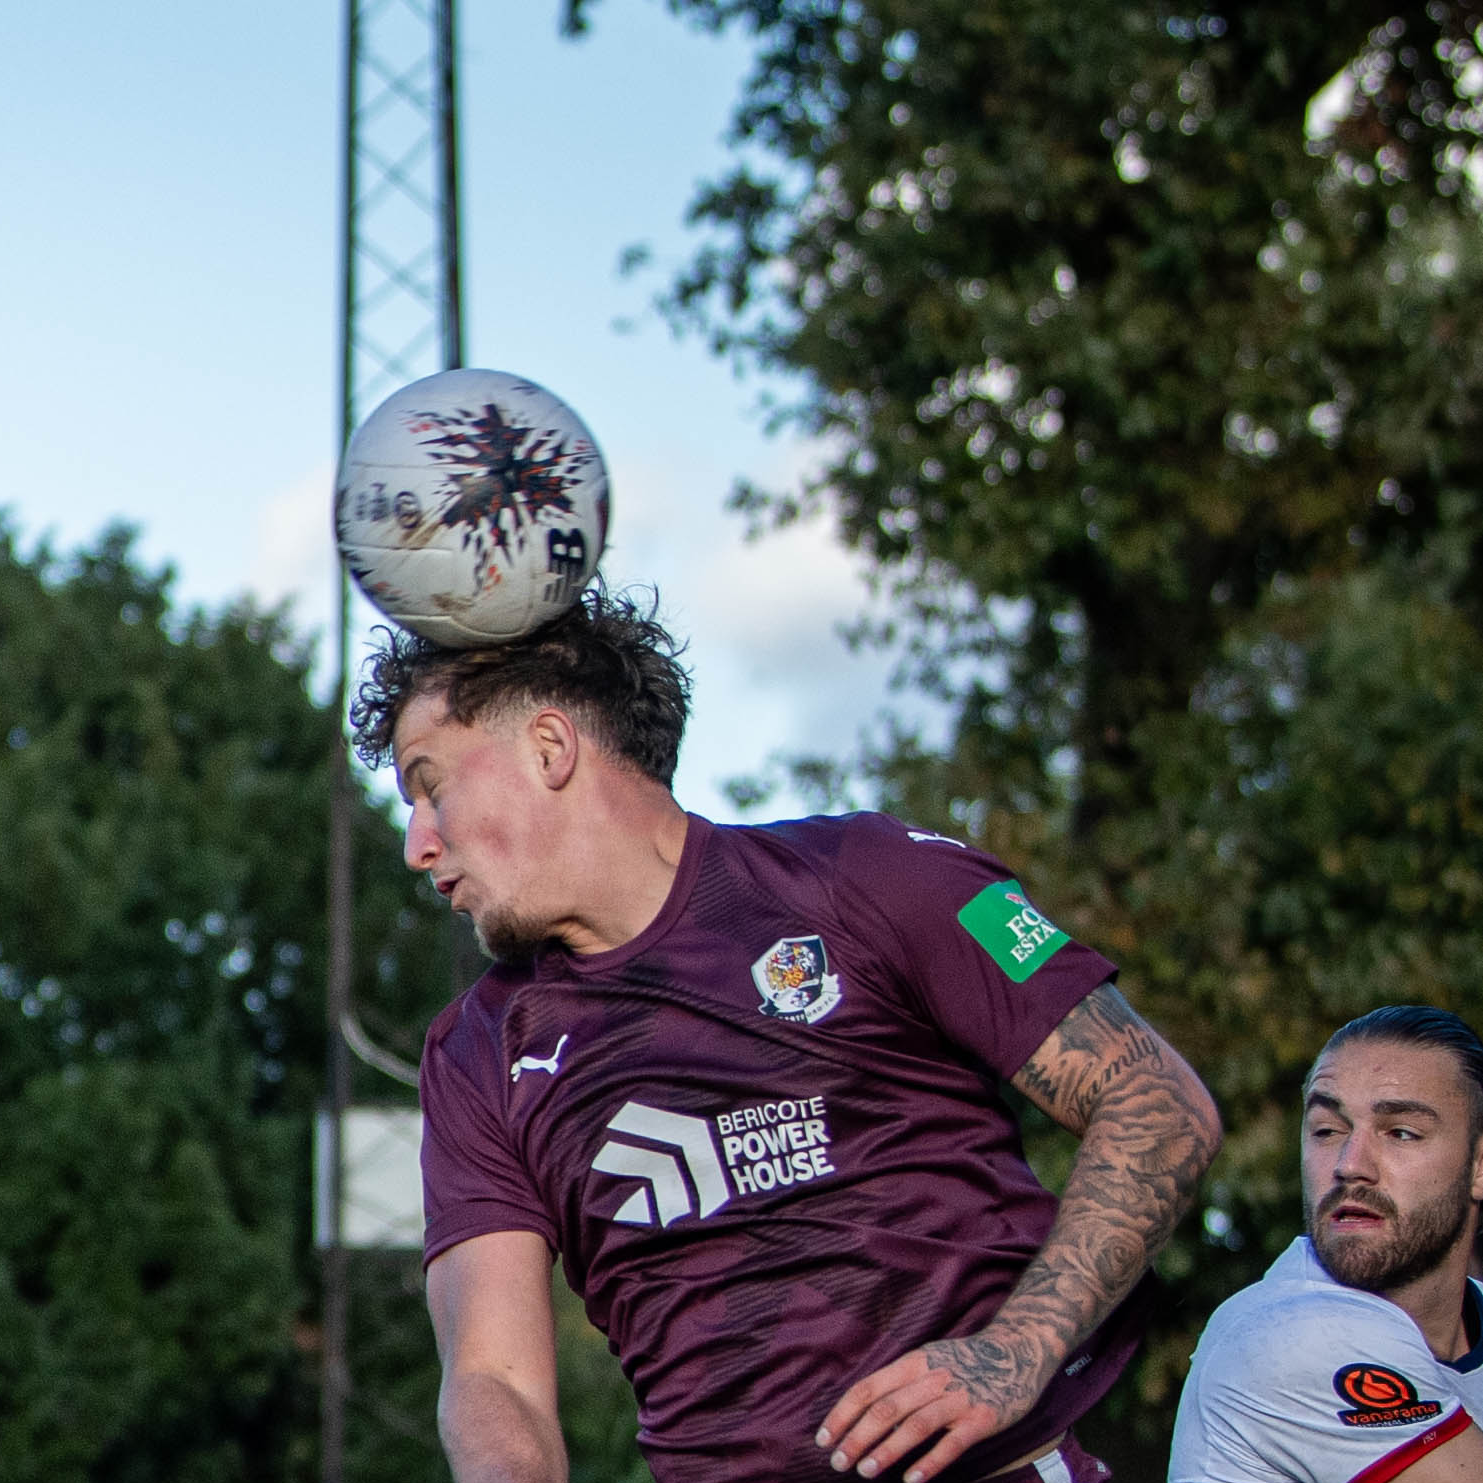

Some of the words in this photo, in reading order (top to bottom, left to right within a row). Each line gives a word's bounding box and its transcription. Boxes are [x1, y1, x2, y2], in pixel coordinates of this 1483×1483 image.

[716, 1096, 827, 1136] BERICOTE
[722, 1119, 831, 1167] POWER
[730, 1146, 835, 1195] HOUSE
[1345, 1403, 1437, 1424] vanarama
